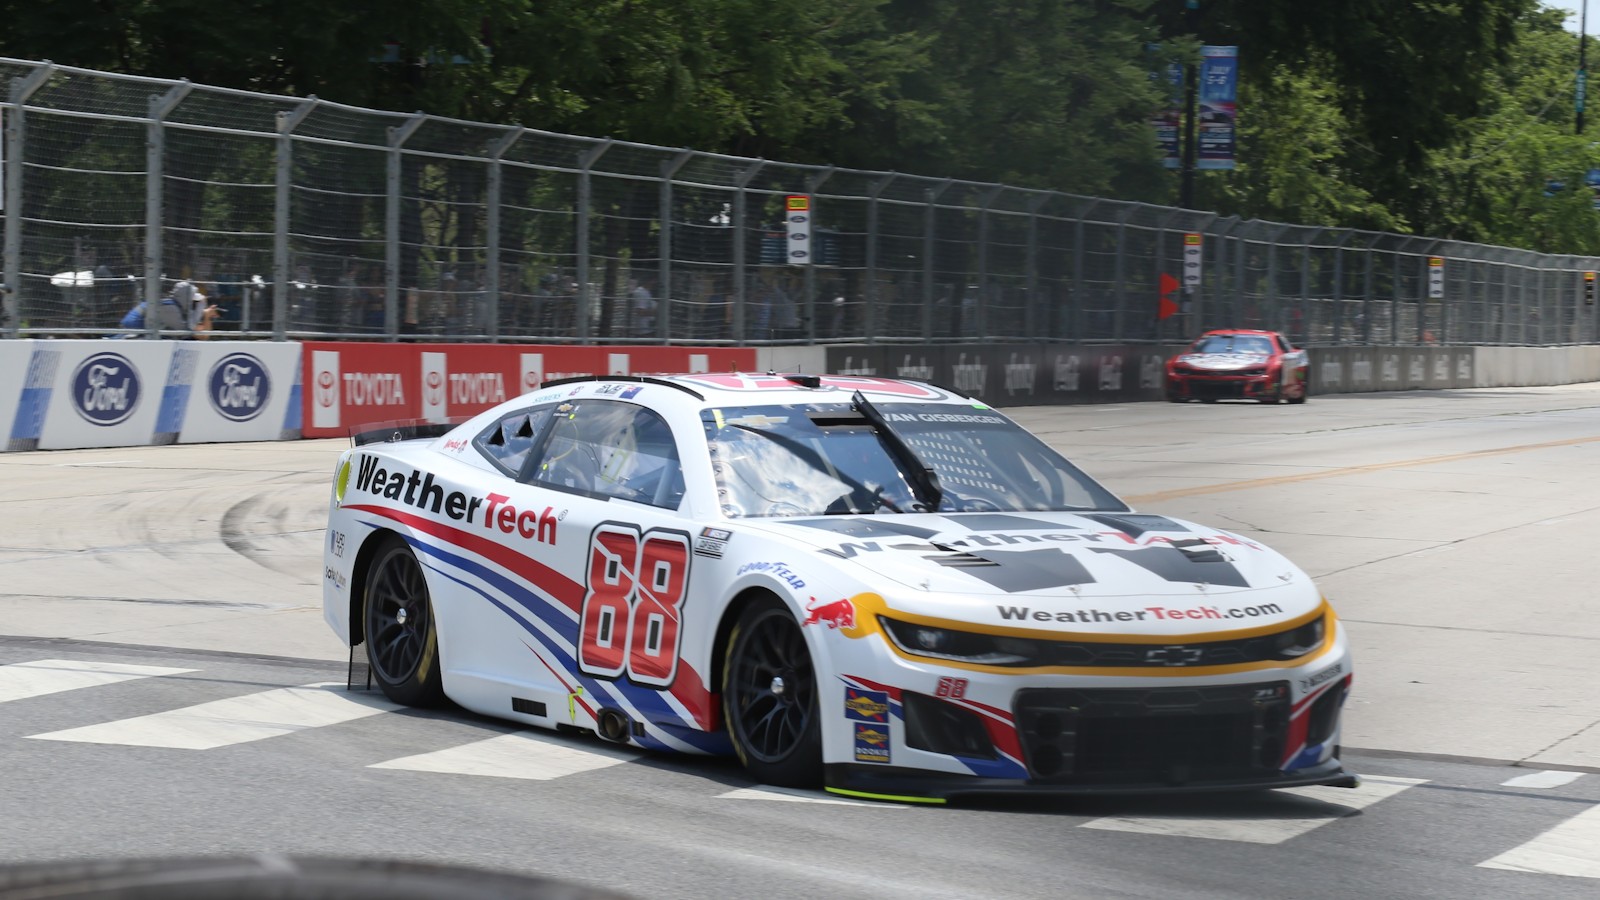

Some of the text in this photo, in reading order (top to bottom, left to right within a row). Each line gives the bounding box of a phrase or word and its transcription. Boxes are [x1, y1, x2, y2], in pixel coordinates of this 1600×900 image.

[84, 364, 130, 411] Ford
[219, 364, 260, 408] Ford
[343, 372, 405, 405] TOYOTA
[449, 372, 507, 404] TOYOTA
[882, 413, 1007, 425] VAN GISBERGEN
[355, 453, 557, 546] WeatherTech
[816, 531, 1264, 560] WtherTeh
[577, 519, 692, 691] 88
[997, 602, 1283, 623] WeatherTech.com
